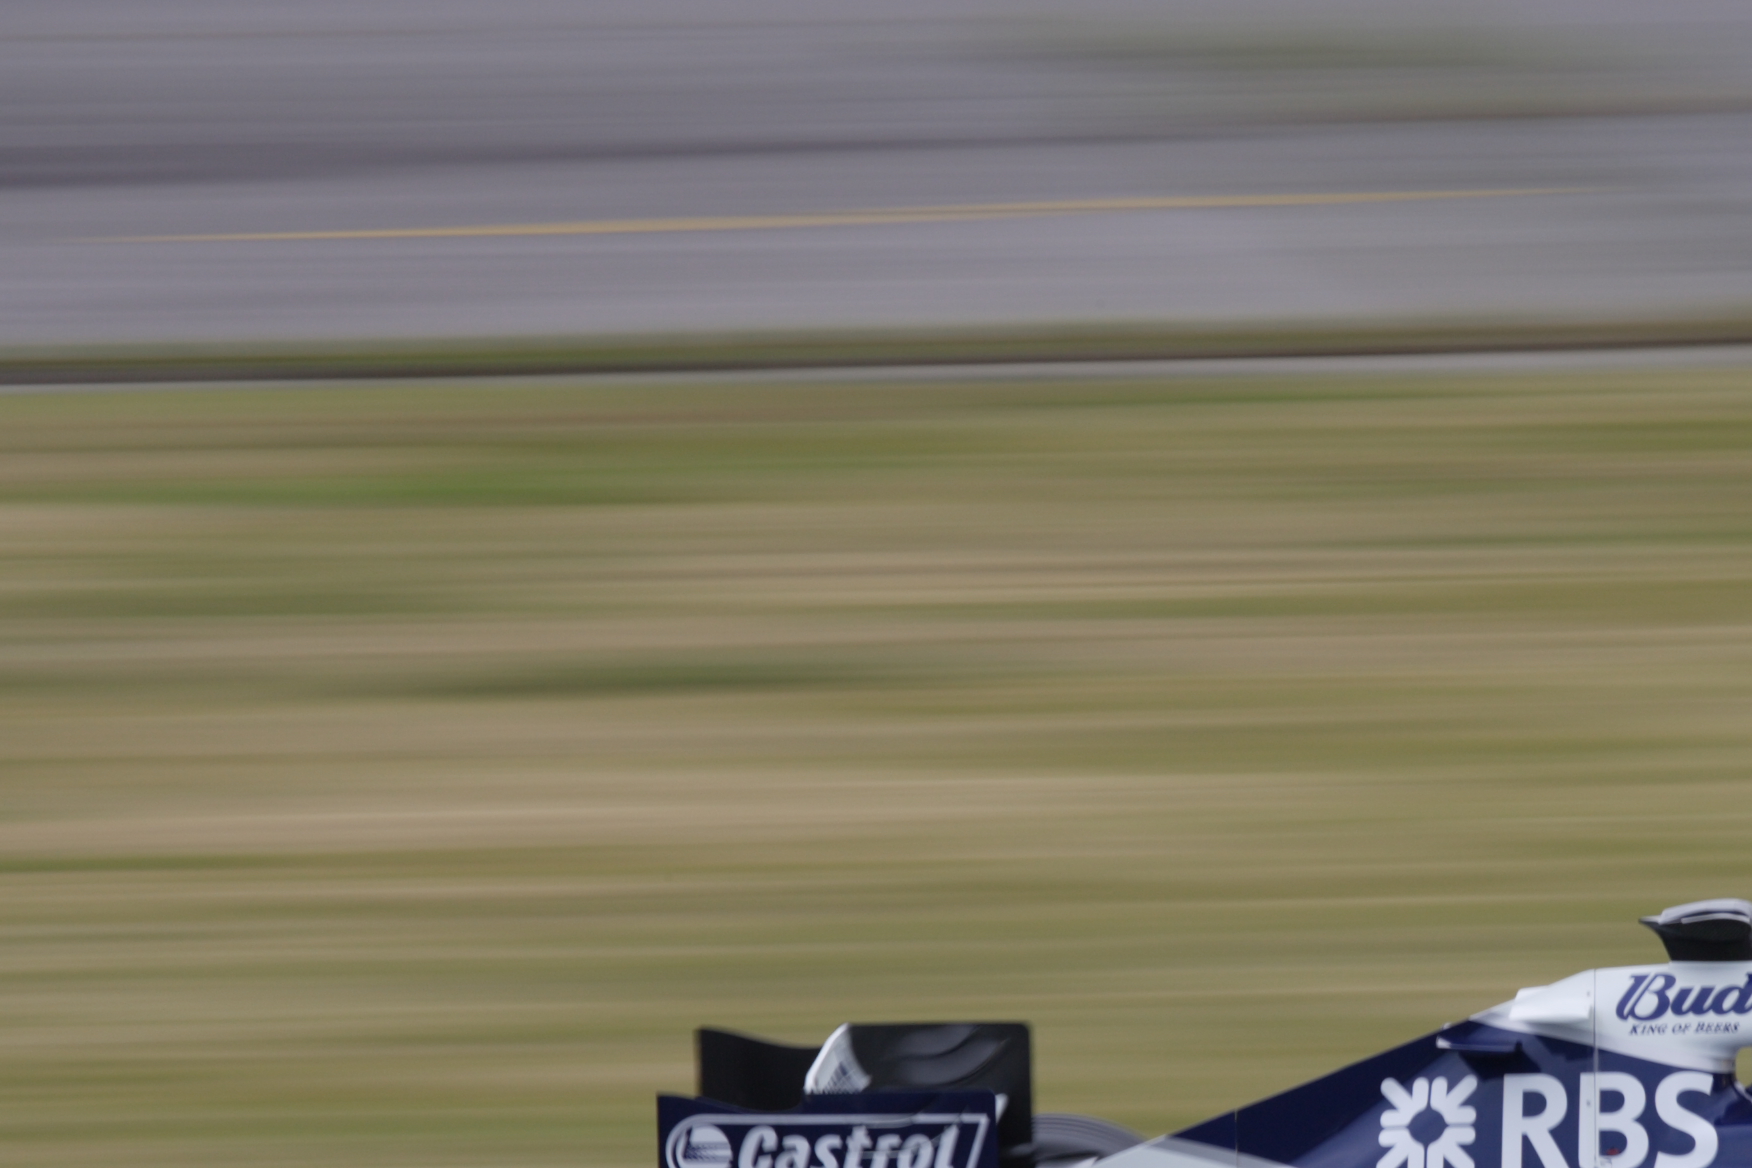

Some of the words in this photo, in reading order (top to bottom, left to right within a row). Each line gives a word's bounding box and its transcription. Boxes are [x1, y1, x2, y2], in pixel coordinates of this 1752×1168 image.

[1629, 1022, 1668, 1036] KING
[1671, 1022, 1691, 1035] OF
[1693, 1021, 1741, 1035] BEERS
